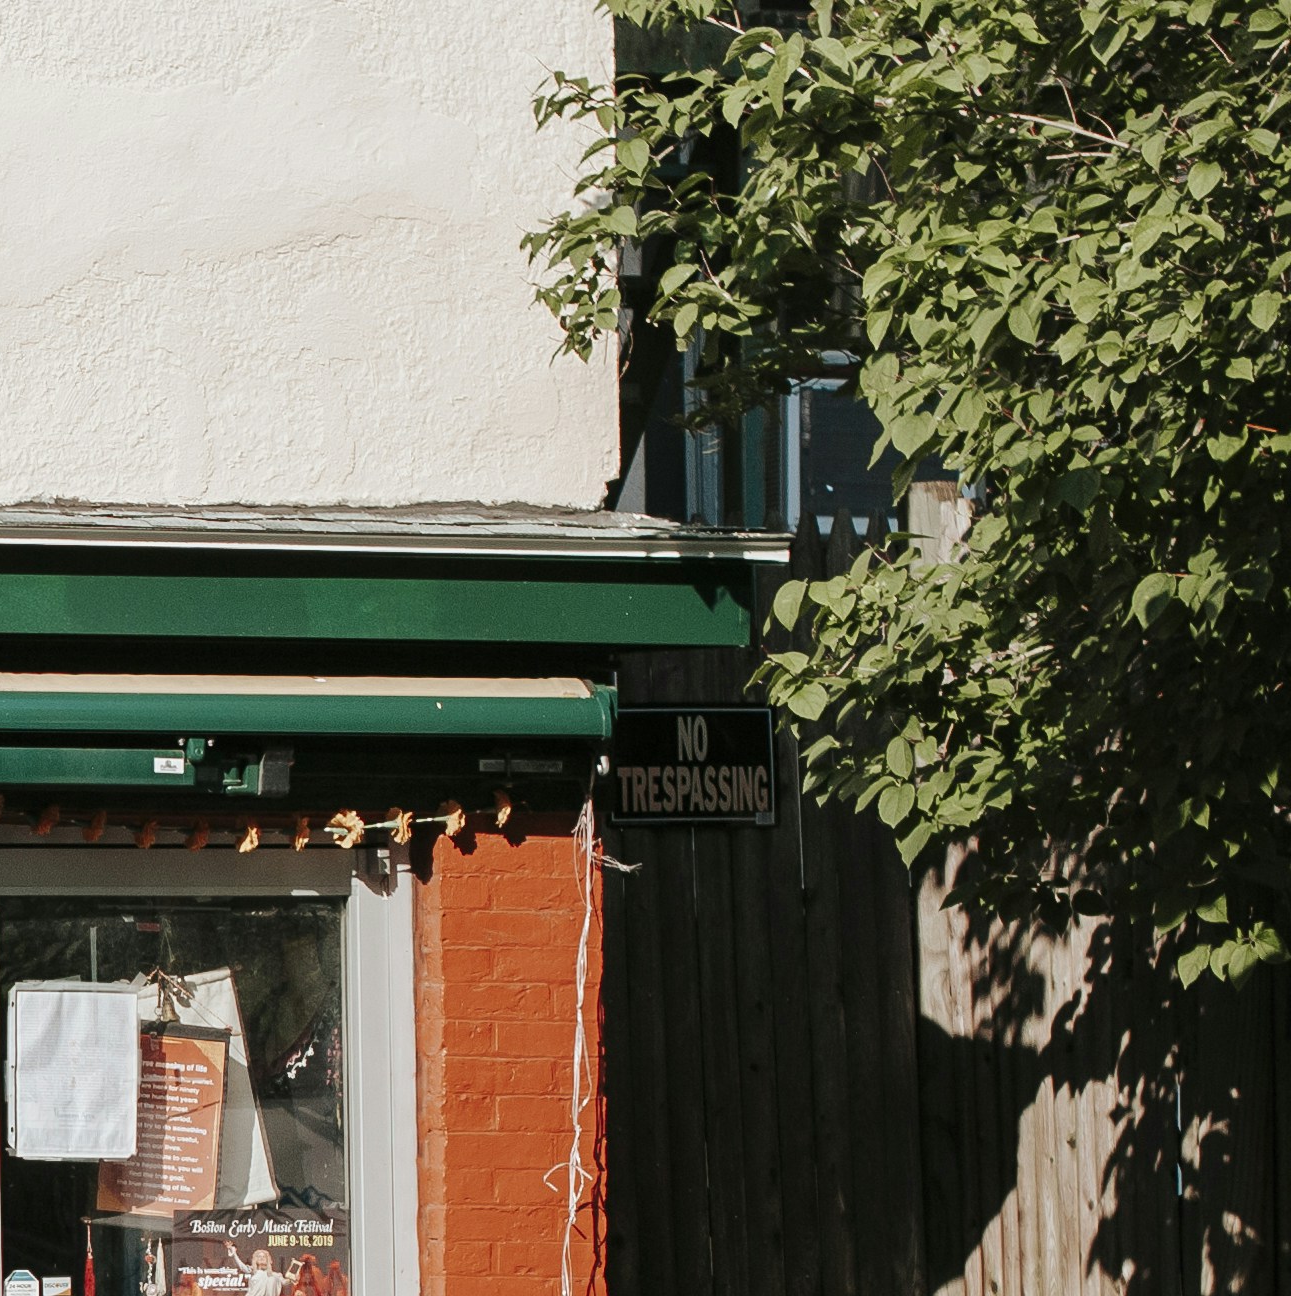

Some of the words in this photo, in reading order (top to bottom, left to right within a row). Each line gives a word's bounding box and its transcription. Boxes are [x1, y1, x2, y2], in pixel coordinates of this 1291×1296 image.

[677, 715, 708, 762] NO
[617, 765, 768, 813] TRESPASSING
[186, 1064, 194, 1072] of
[195, 1064, 208, 1073] life
[179, 1087, 199, 1095] ninety
[155, 1104, 170, 1112] very
[172, 1126, 207, 1136] something
[189, 1219, 225, 1234] Boston
[228, 1219, 257, 1238] Early
[257, 1220, 293, 1235] Music
[294, 1219, 333, 1233] Festival
[268, 1235, 288, 1247] JUNE
[312, 1235, 334, 1247] 2019
[198, 1274, 252, 1289] special."
